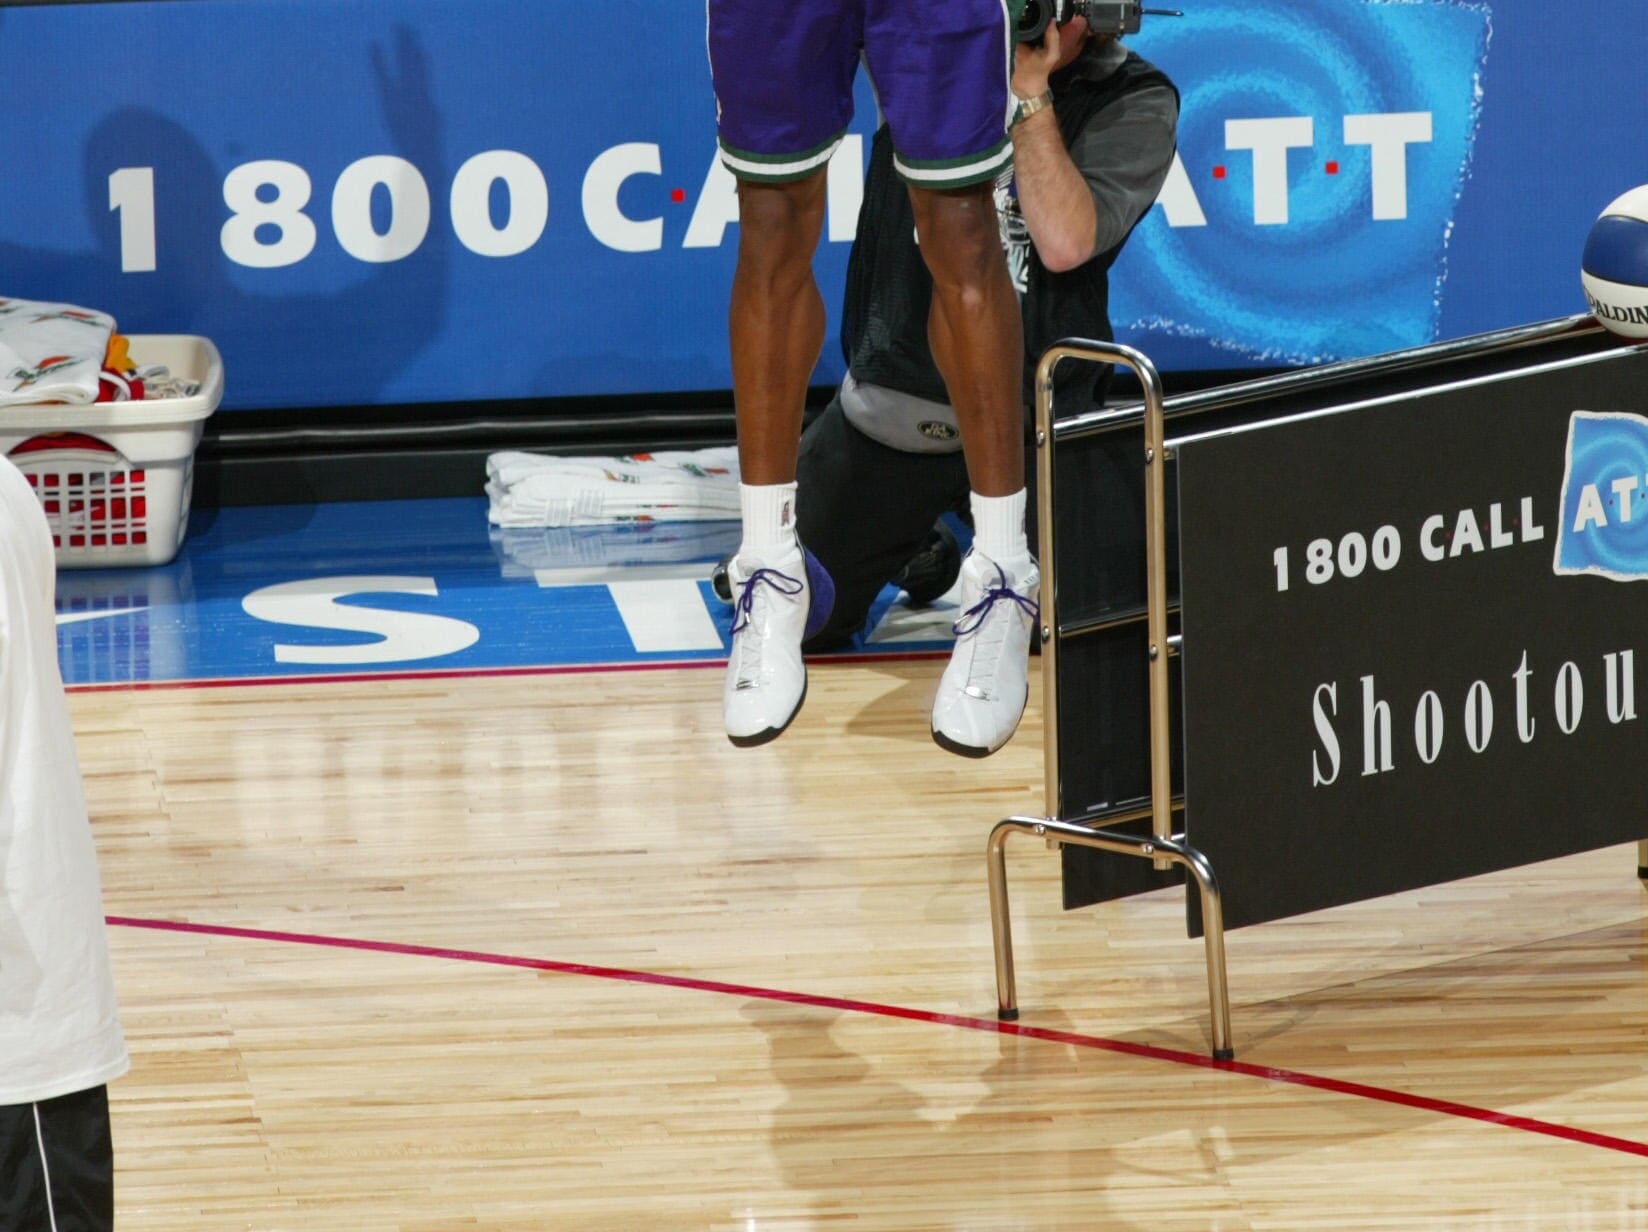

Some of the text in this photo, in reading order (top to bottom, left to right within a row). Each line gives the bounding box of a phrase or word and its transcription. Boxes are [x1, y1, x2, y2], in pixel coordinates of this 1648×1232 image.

[108, 167, 156, 273] 1
[220, 150, 549, 268] 800
[1584, 284, 1648, 325] PALDIN
[1273, 546, 1289, 592] 1
[1305, 524, 1402, 585] 800
[1572, 474, 1648, 533] AT
[1312, 648, 1638, 788] Shootou
